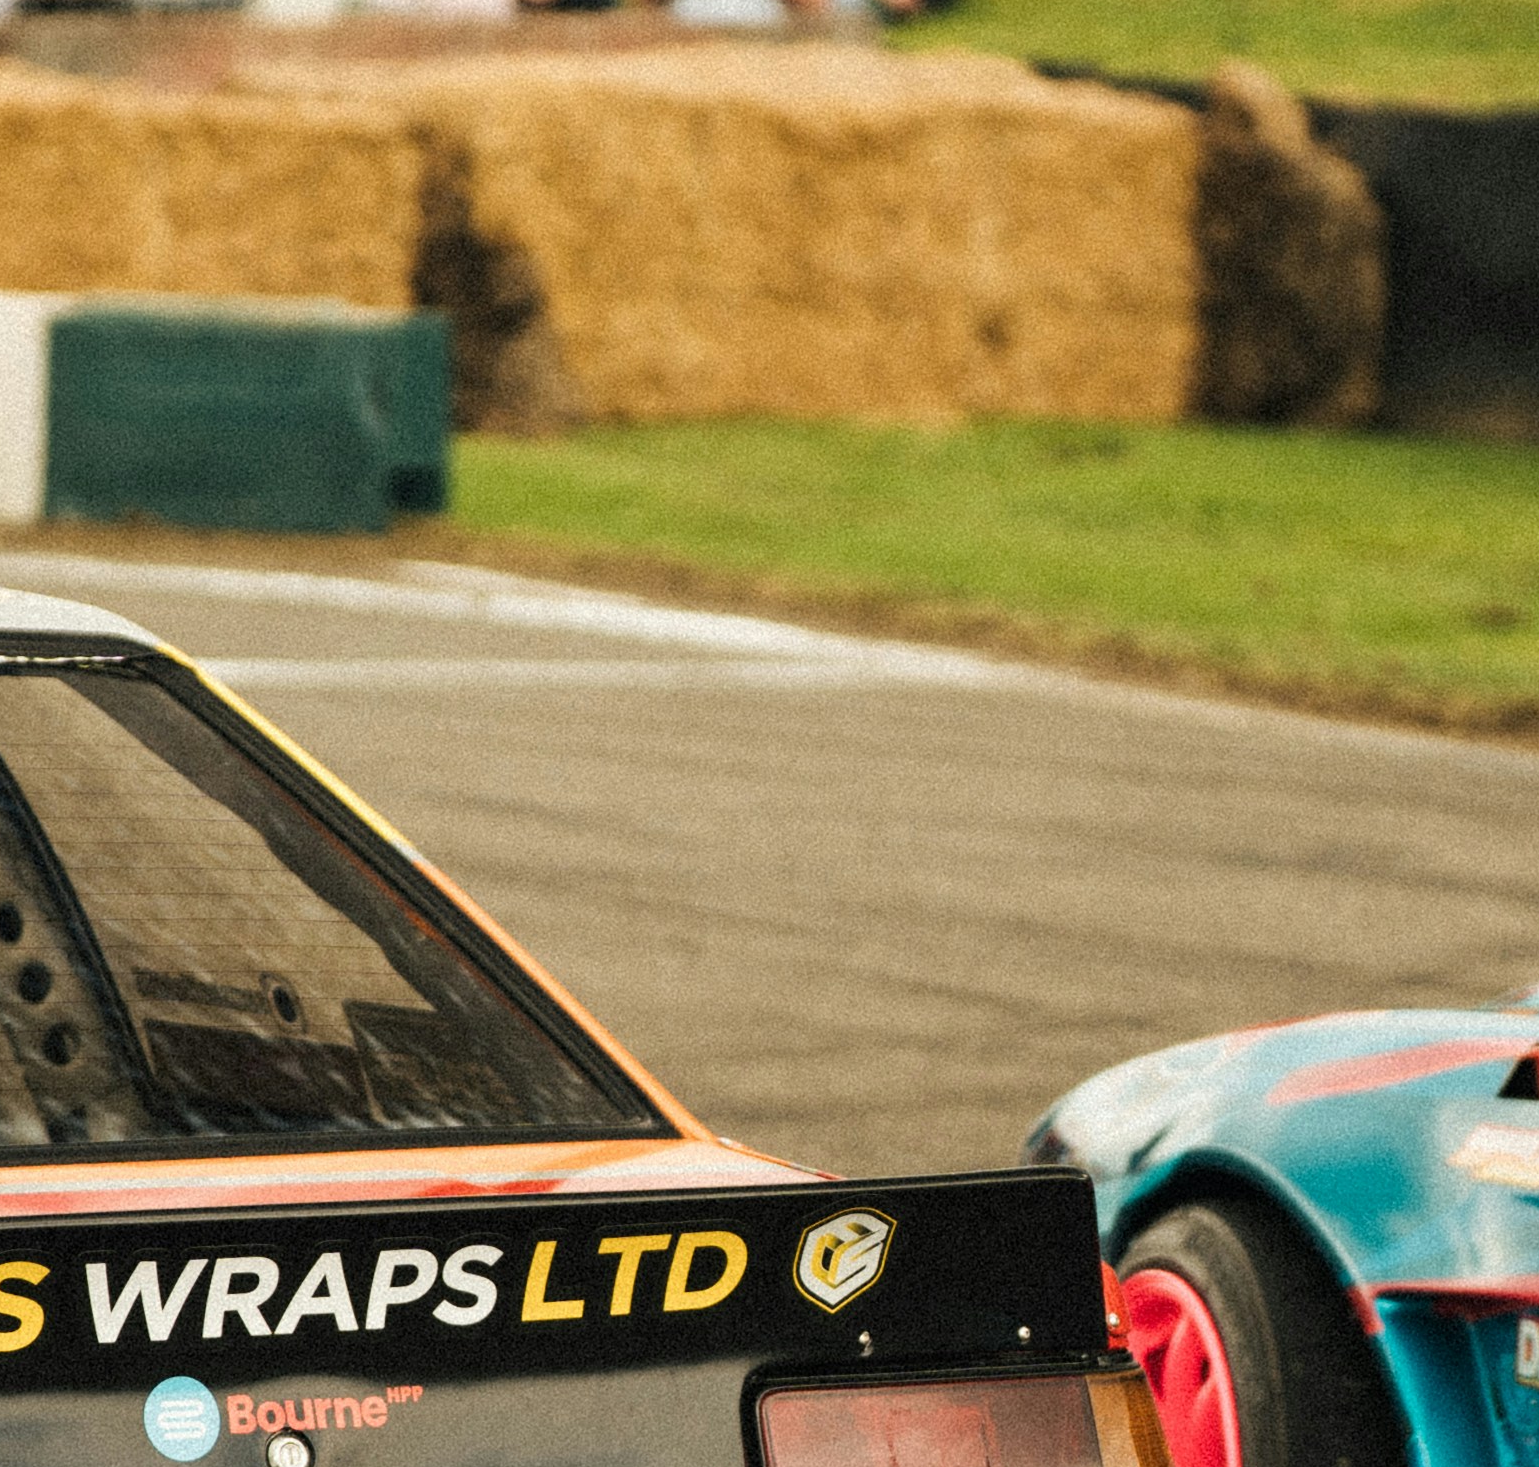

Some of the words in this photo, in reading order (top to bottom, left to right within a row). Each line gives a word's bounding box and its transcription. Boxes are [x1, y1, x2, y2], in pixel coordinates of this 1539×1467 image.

[84, 1243, 505, 1344] WRAPS
[520, 1230, 748, 1322] LTD
[225, 1392, 388, 1435] Bourne
[386, 1384, 425, 1404] HPP
